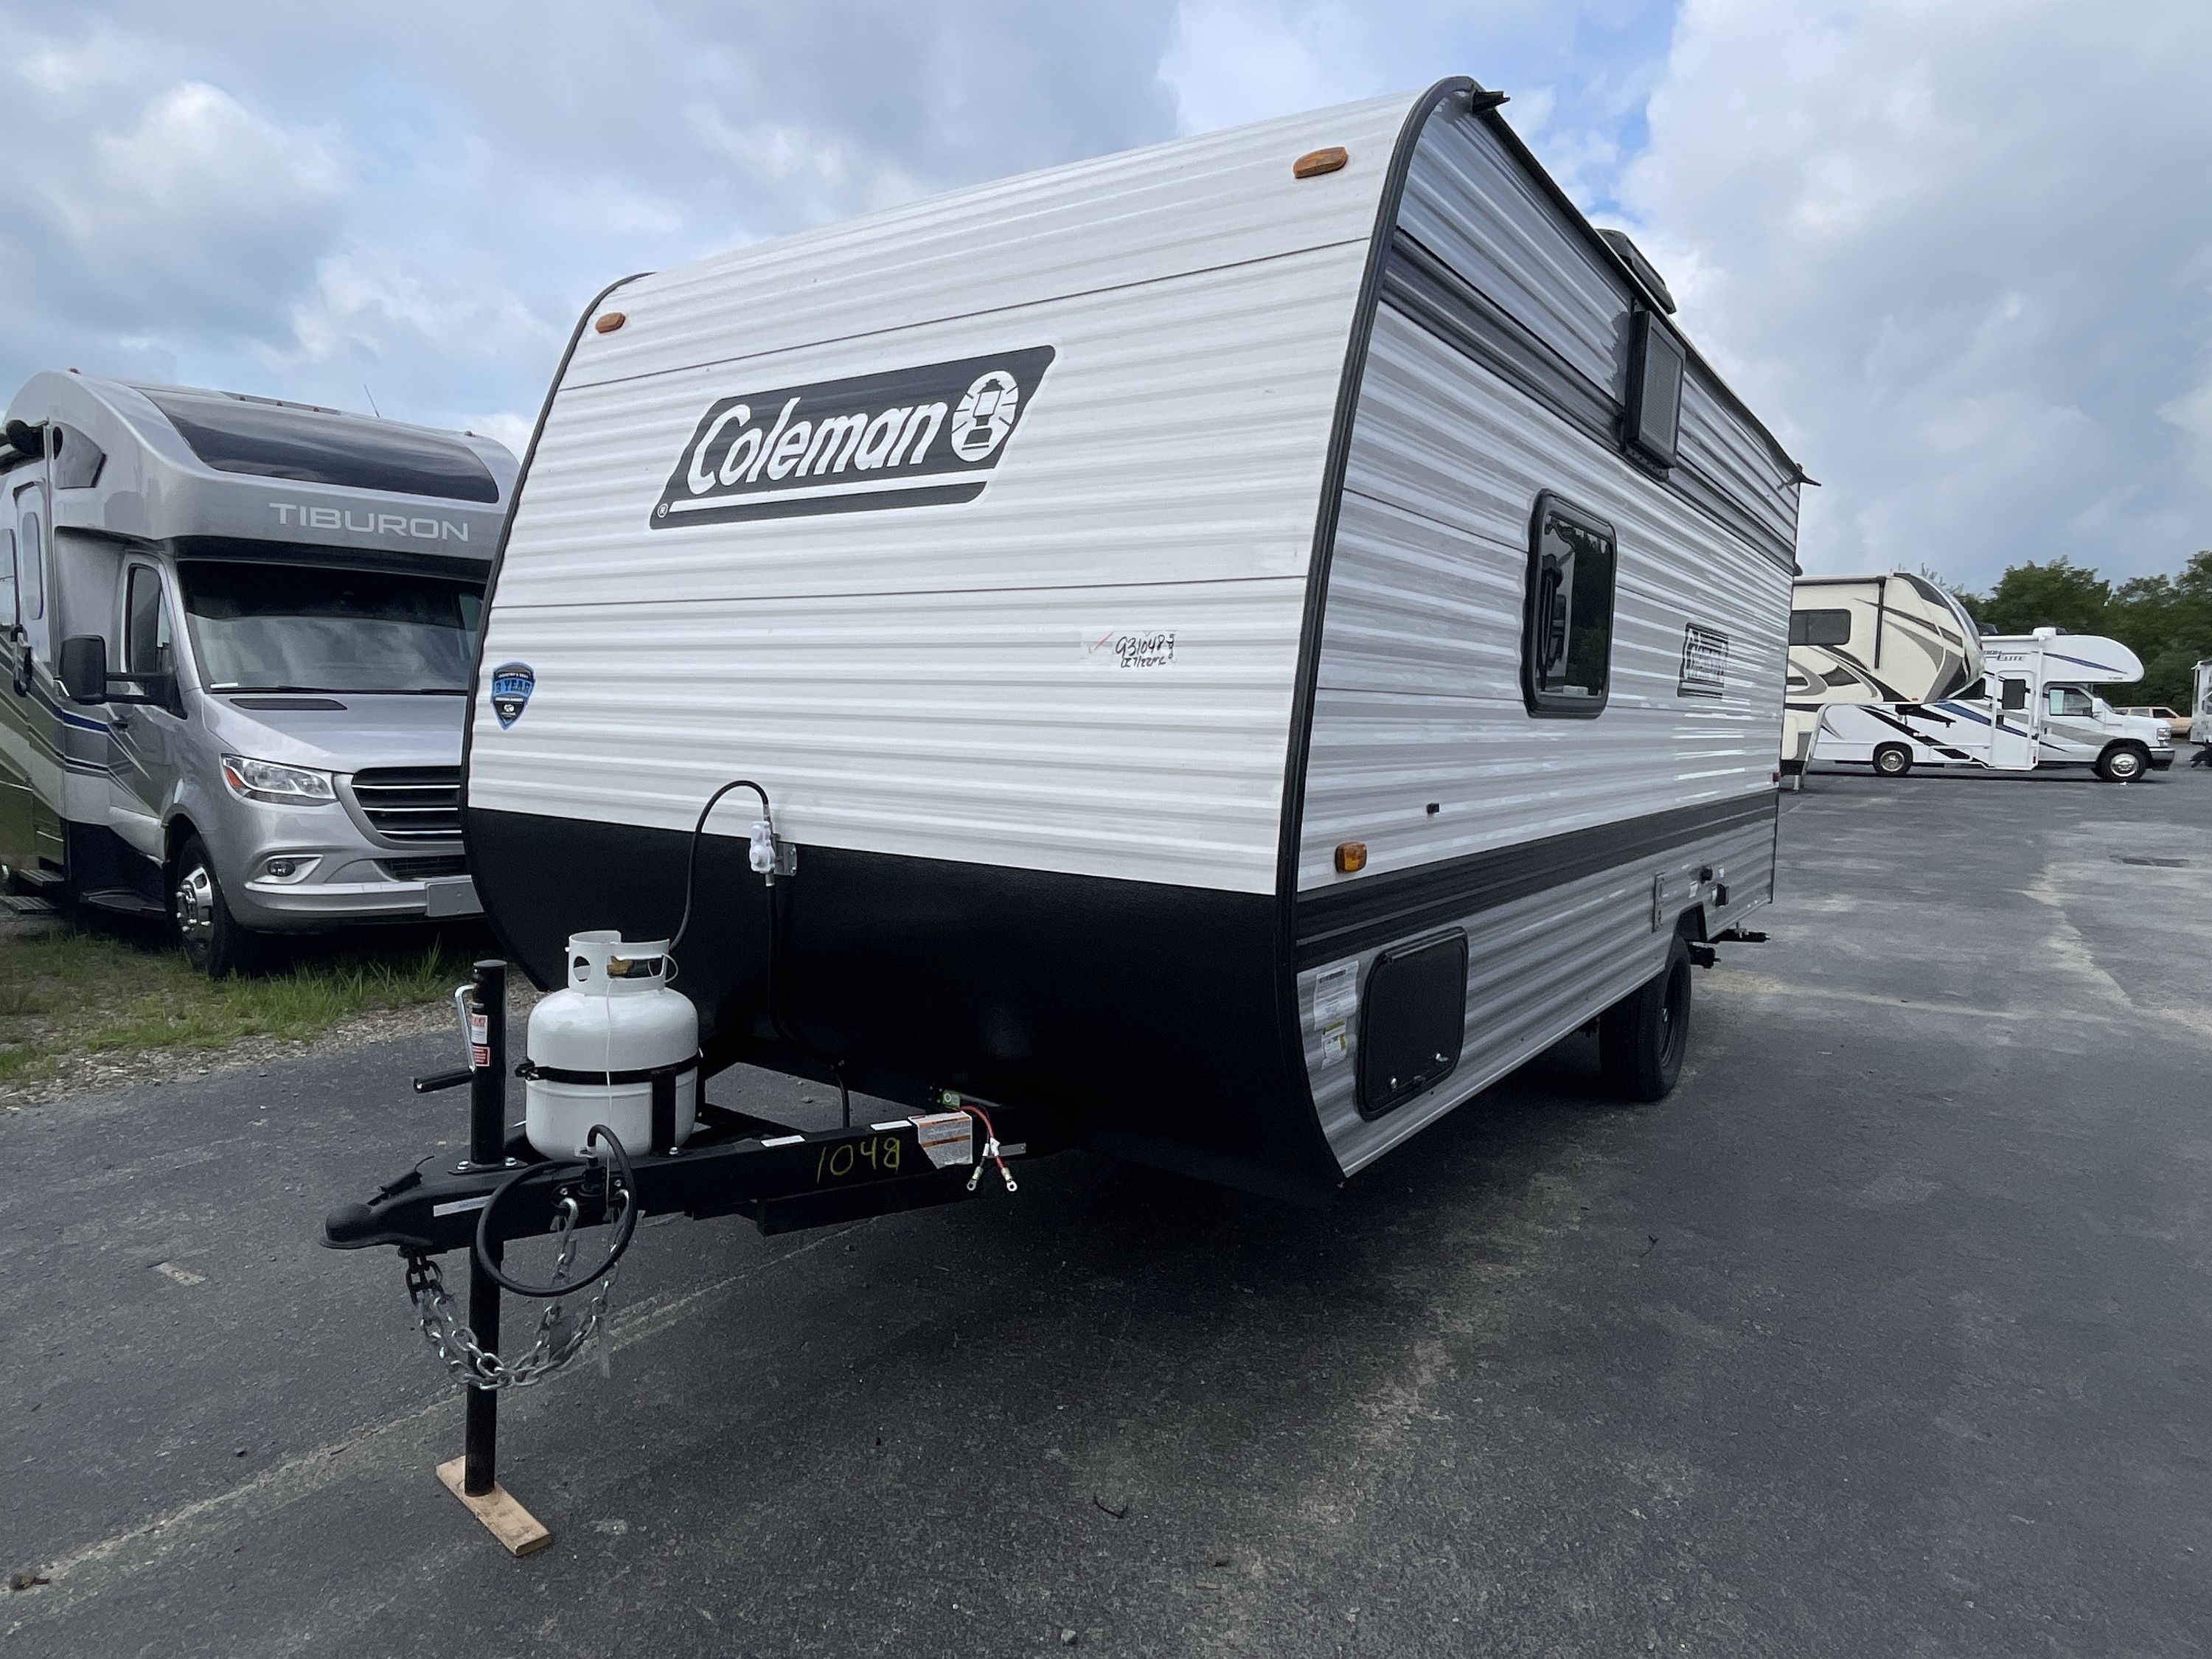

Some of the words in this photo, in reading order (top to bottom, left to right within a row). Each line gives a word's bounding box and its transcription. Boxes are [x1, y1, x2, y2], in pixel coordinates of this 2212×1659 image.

[686, 397, 949, 495] Coleman
[268, 502, 470, 543] TIBURON
[504, 680, 530, 694] YEAR
